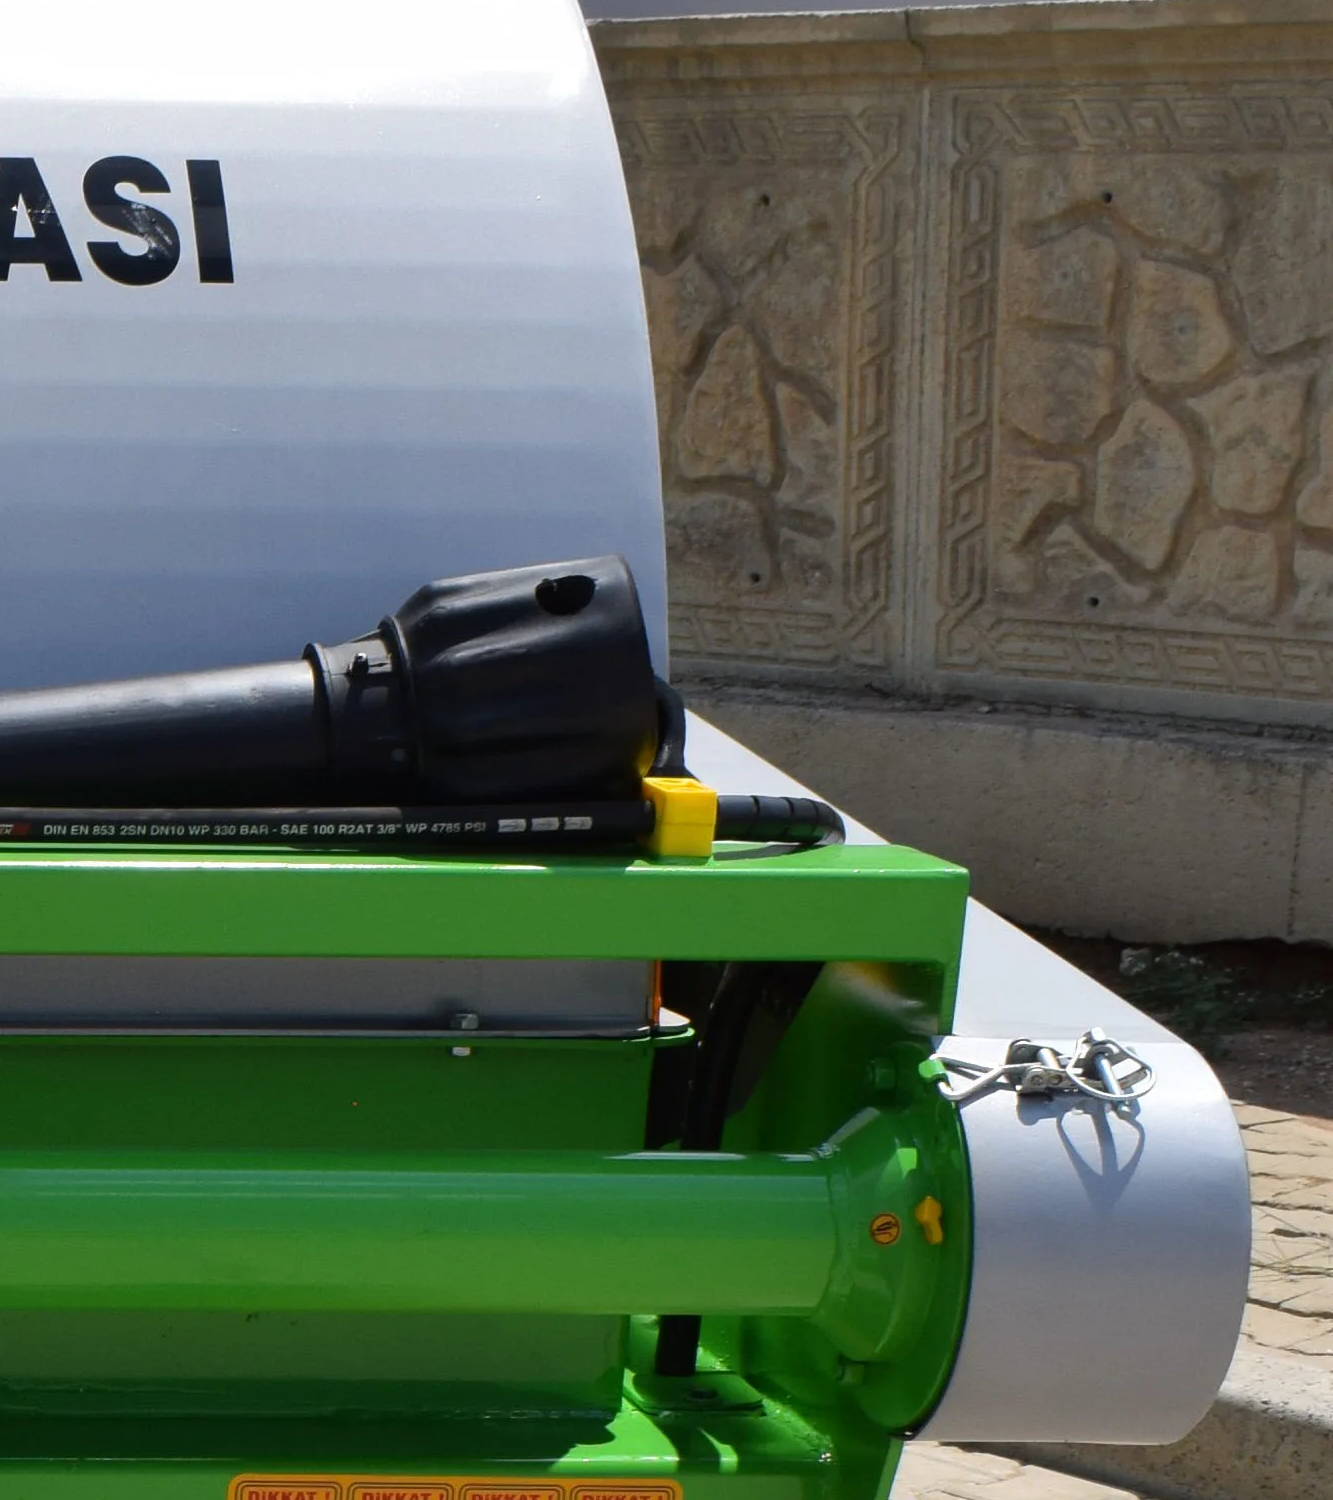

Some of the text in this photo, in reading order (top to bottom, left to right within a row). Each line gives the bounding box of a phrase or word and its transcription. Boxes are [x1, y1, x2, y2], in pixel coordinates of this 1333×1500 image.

[43, 825, 66, 836] DIN
[71, 825, 89, 836] EN
[92, 825, 115, 836] 853
[120, 825, 146, 836] 2SN
[150, 825, 185, 836] DN10
[189, 825, 210, 836] WP
[213, 825, 236, 836] 330
[240, 825, 269, 836] BAR
[280, 824, 308, 835] SAE
[313, 824, 334, 835] 100
[338, 824, 373, 835] R2AT
[405, 823, 427, 834] WP
[431, 822, 461, 833] 4785
[464, 821, 487, 832] PSI
